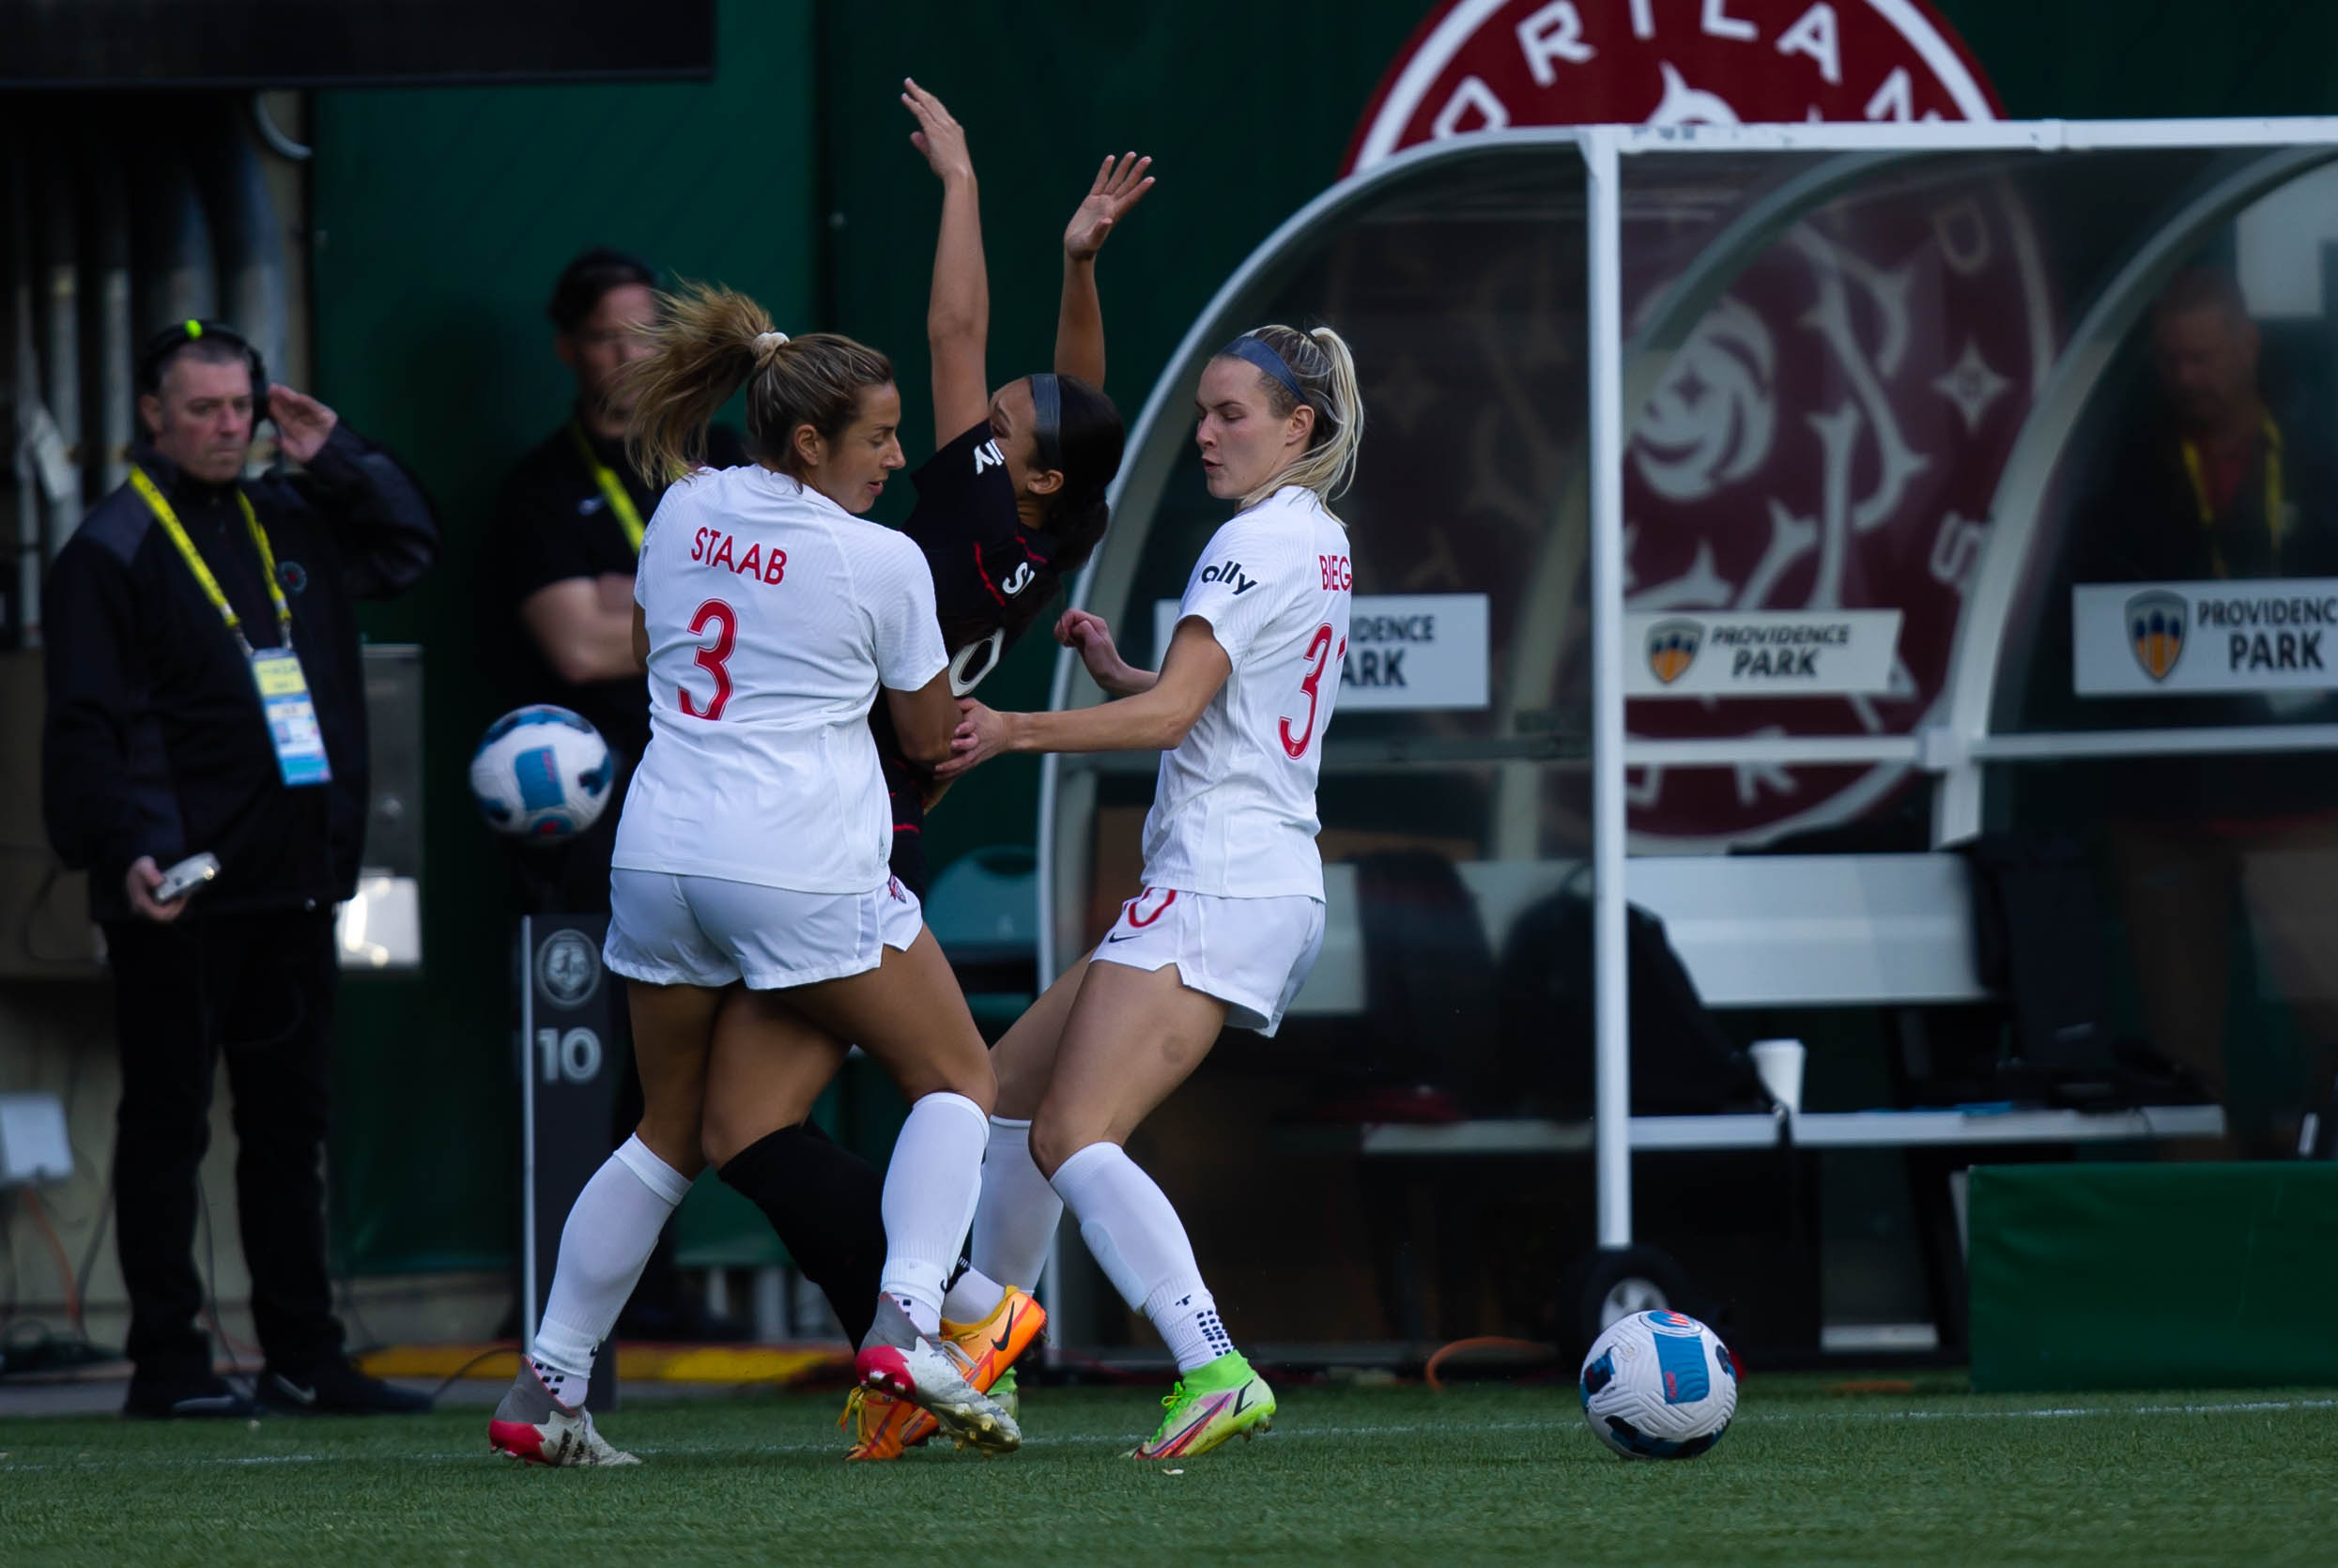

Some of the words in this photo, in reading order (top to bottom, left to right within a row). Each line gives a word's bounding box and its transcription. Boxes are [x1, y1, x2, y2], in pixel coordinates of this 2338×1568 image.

[690, 527, 788, 585] STAAB
[1201, 561, 1258, 595] ally
[1712, 624, 1849, 645] PROVIDENCE
[2229, 631, 2324, 670] PARK
[677, 598, 739, 722] 3
[1733, 648, 1817, 676] PARK
[1278, 623, 1347, 760] 3
[537, 1025, 604, 1084] 10
